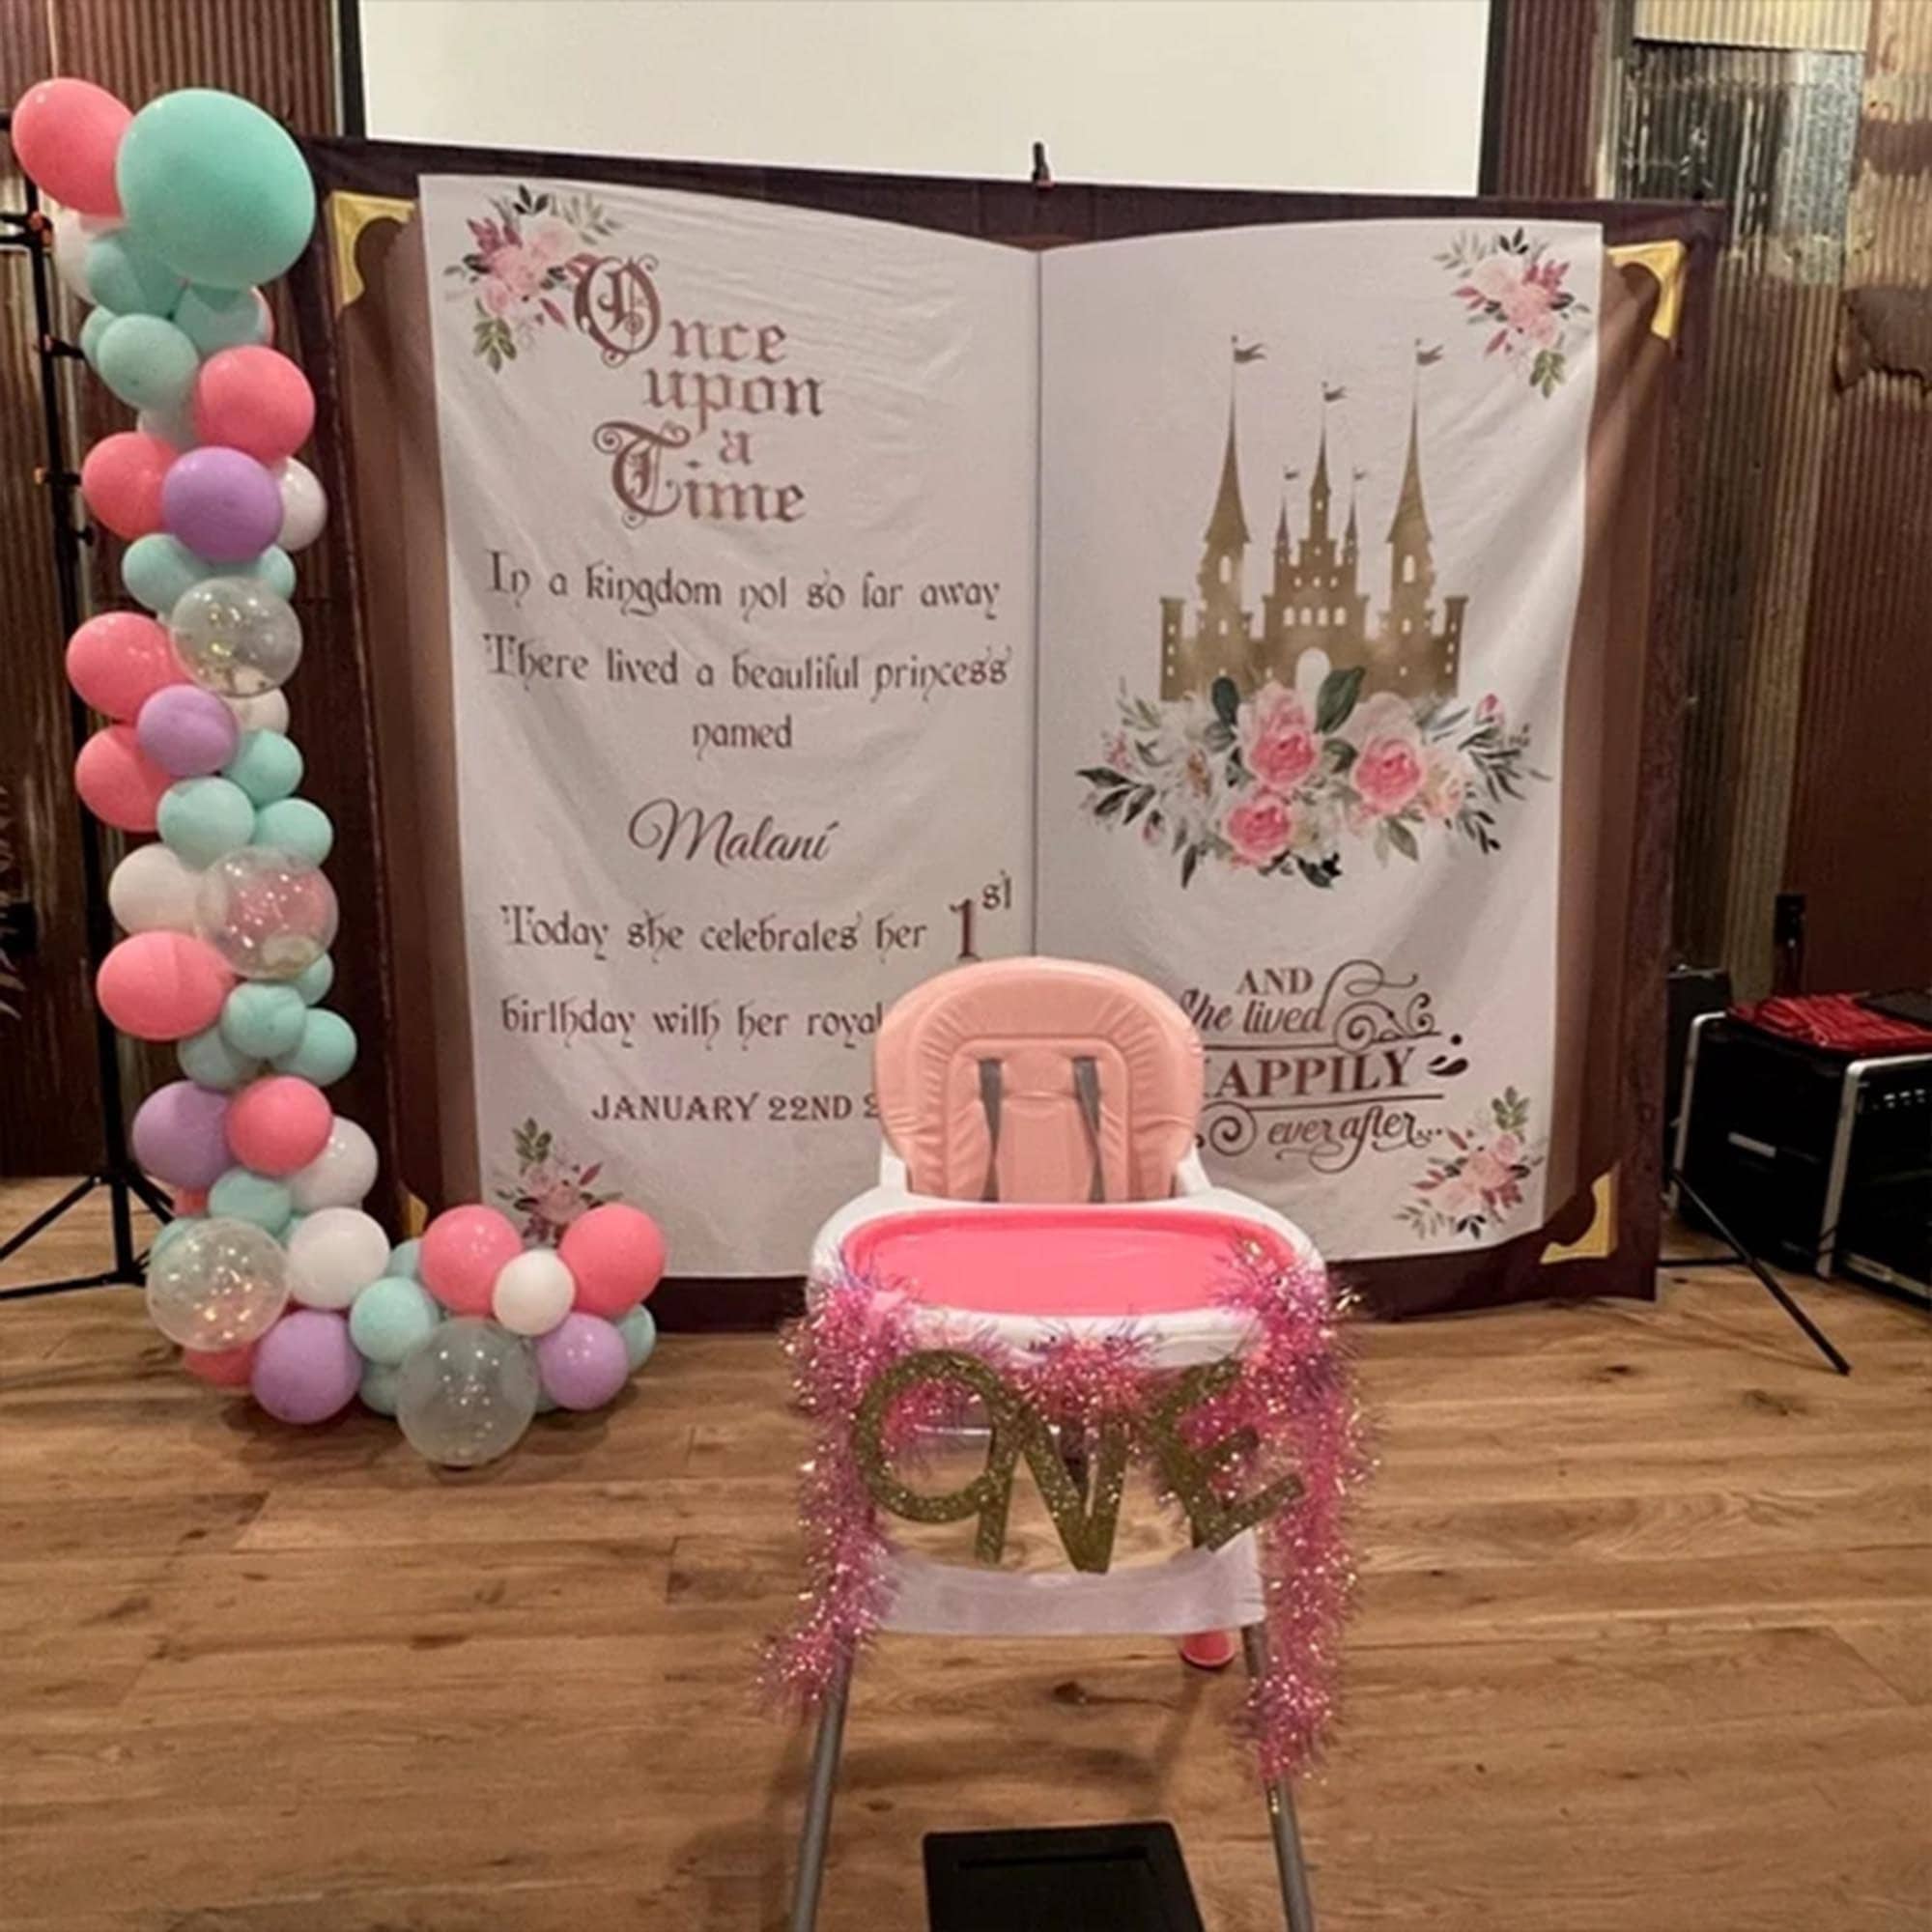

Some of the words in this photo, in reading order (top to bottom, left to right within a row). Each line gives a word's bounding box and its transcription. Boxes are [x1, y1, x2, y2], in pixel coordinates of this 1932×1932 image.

[573, 253, 786, 367] Once
[642, 367, 824, 433] upon
[593, 421, 808, 529] Time
[719, 430, 753, 465] a
[486, 551, 530, 609] In
[549, 573, 568, 595] a
[586, 559, 722, 616] kingdom
[739, 575, 787, 622] not
[806, 568, 844, 610] so
[862, 572, 903, 609] far
[920, 580, 1001, 620] away
[482, 633, 588, 690] There
[607, 647, 678, 686] lived
[696, 663, 715, 686] a
[731, 647, 860, 690] beautiful
[870, 645, 1012, 703] princess
[691, 715, 793, 760] named
[500, 903, 609, 960] Today
[626, 908, 684, 964] she
[699, 911, 863, 952] celebrates
[874, 916, 928, 963] her
[1236, 968, 1314, 996] AND
[500, 995, 636, 1048] birthday
[653, 1003, 721, 1049] with
[737, 1003, 789, 1050] her
[807, 1000, 884, 1049] royal
[1242, 998, 1327, 1034] lived
[1203, 1048, 1415, 1098] APPILY
[590, 1091, 759, 1122] JANUARY
[768, 1094, 853, 1121] 22ND
[1266, 1115, 1339, 1155] ever
[853, 1349, 1306, 1575] ONE
